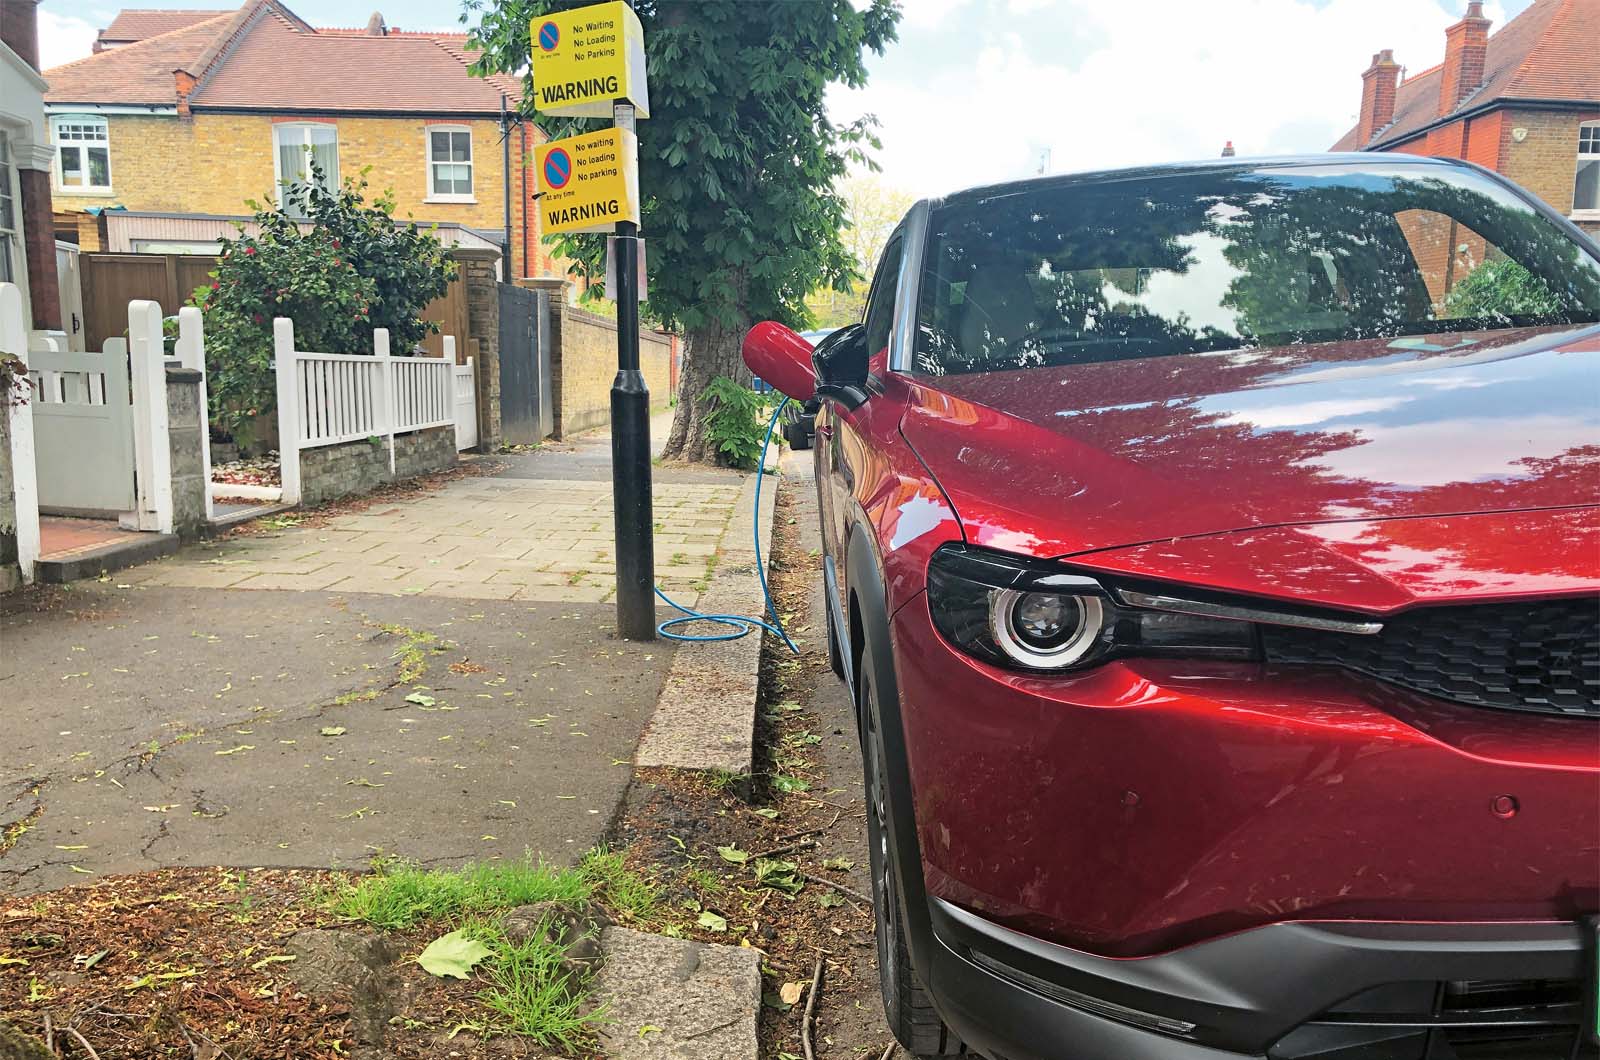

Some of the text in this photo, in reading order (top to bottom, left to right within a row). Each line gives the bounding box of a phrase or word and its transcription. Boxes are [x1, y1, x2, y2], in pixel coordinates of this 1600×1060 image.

[573, 20, 614, 34] No Waiting
[574, 34, 615, 47] No Loading
[575, 48, 615, 61] No Parking
[542, 76, 618, 104] WARNING
[576, 138, 614, 152] No waiting
[589, 153, 615, 164] loading
[578, 168, 617, 181] No parking
[548, 199, 619, 226] WARNING
